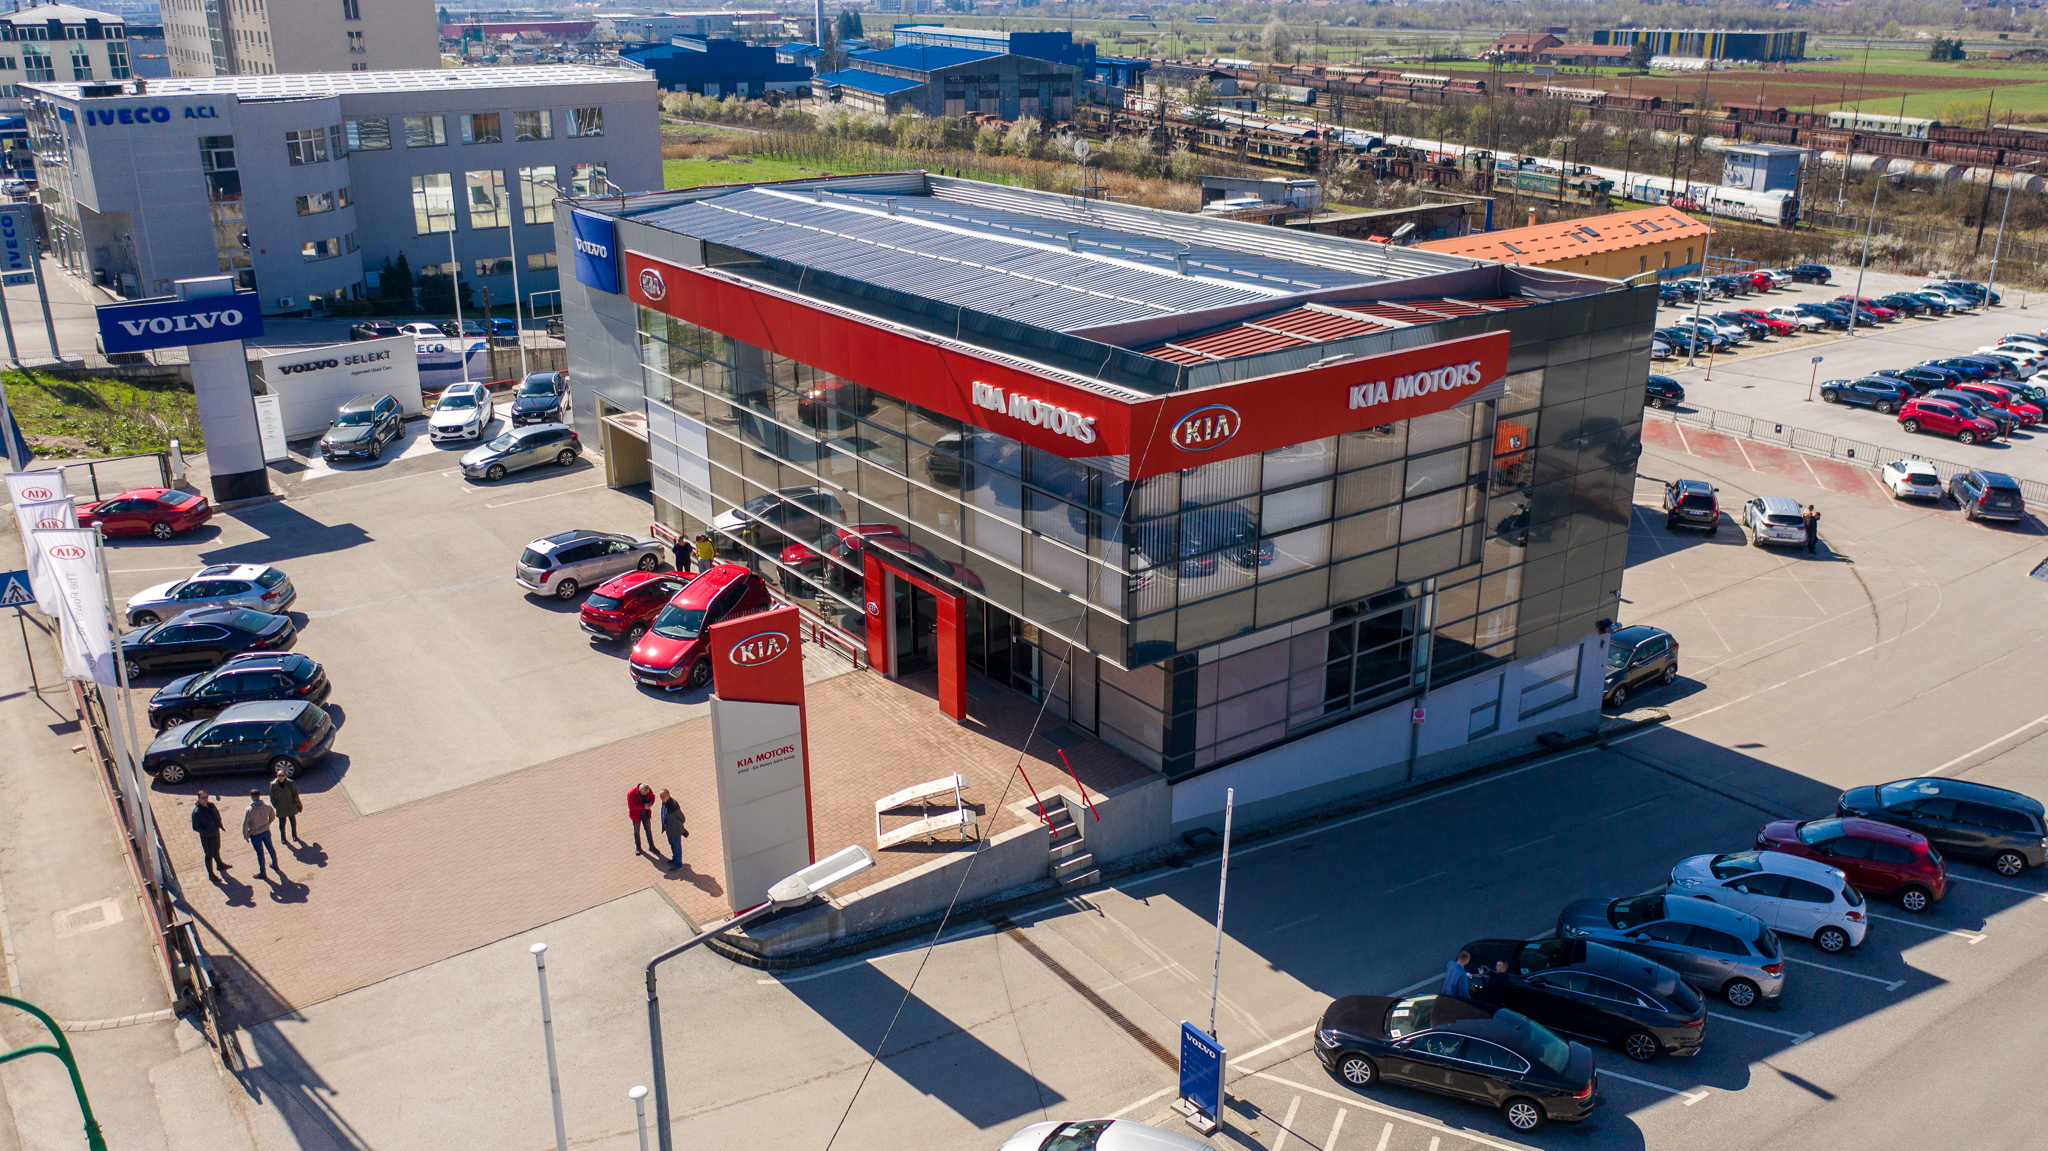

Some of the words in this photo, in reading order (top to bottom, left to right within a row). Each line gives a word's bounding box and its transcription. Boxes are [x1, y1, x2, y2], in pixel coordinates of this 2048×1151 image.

[86, 106, 171, 126] IVECO
[184, 106, 219, 119] A.C.I.
[1, 215, 22, 269] IVECO
[575, 237, 608, 258] VOLVO
[642, 274, 661, 295] KIA
[118, 309, 243, 336] VOLVO
[417, 343, 445, 353] ECO
[278, 358, 339, 375] VOLVO
[344, 350, 392, 366] SELEKT
[351, 368, 371, 376] Approved
[1349, 380, 1389, 410] KIA
[1391, 360, 1481, 401] MOTORS
[972, 381, 1007, 414] KIA
[1008, 393, 1097, 444] MOTORS
[1184, 414, 1230, 444] KIA
[740, 637, 781, 662] KIA
[737, 755, 754, 768] KIA
[755, 744, 795, 763] MOTORS
[1185, 1031, 1216, 1059] VOLVO
